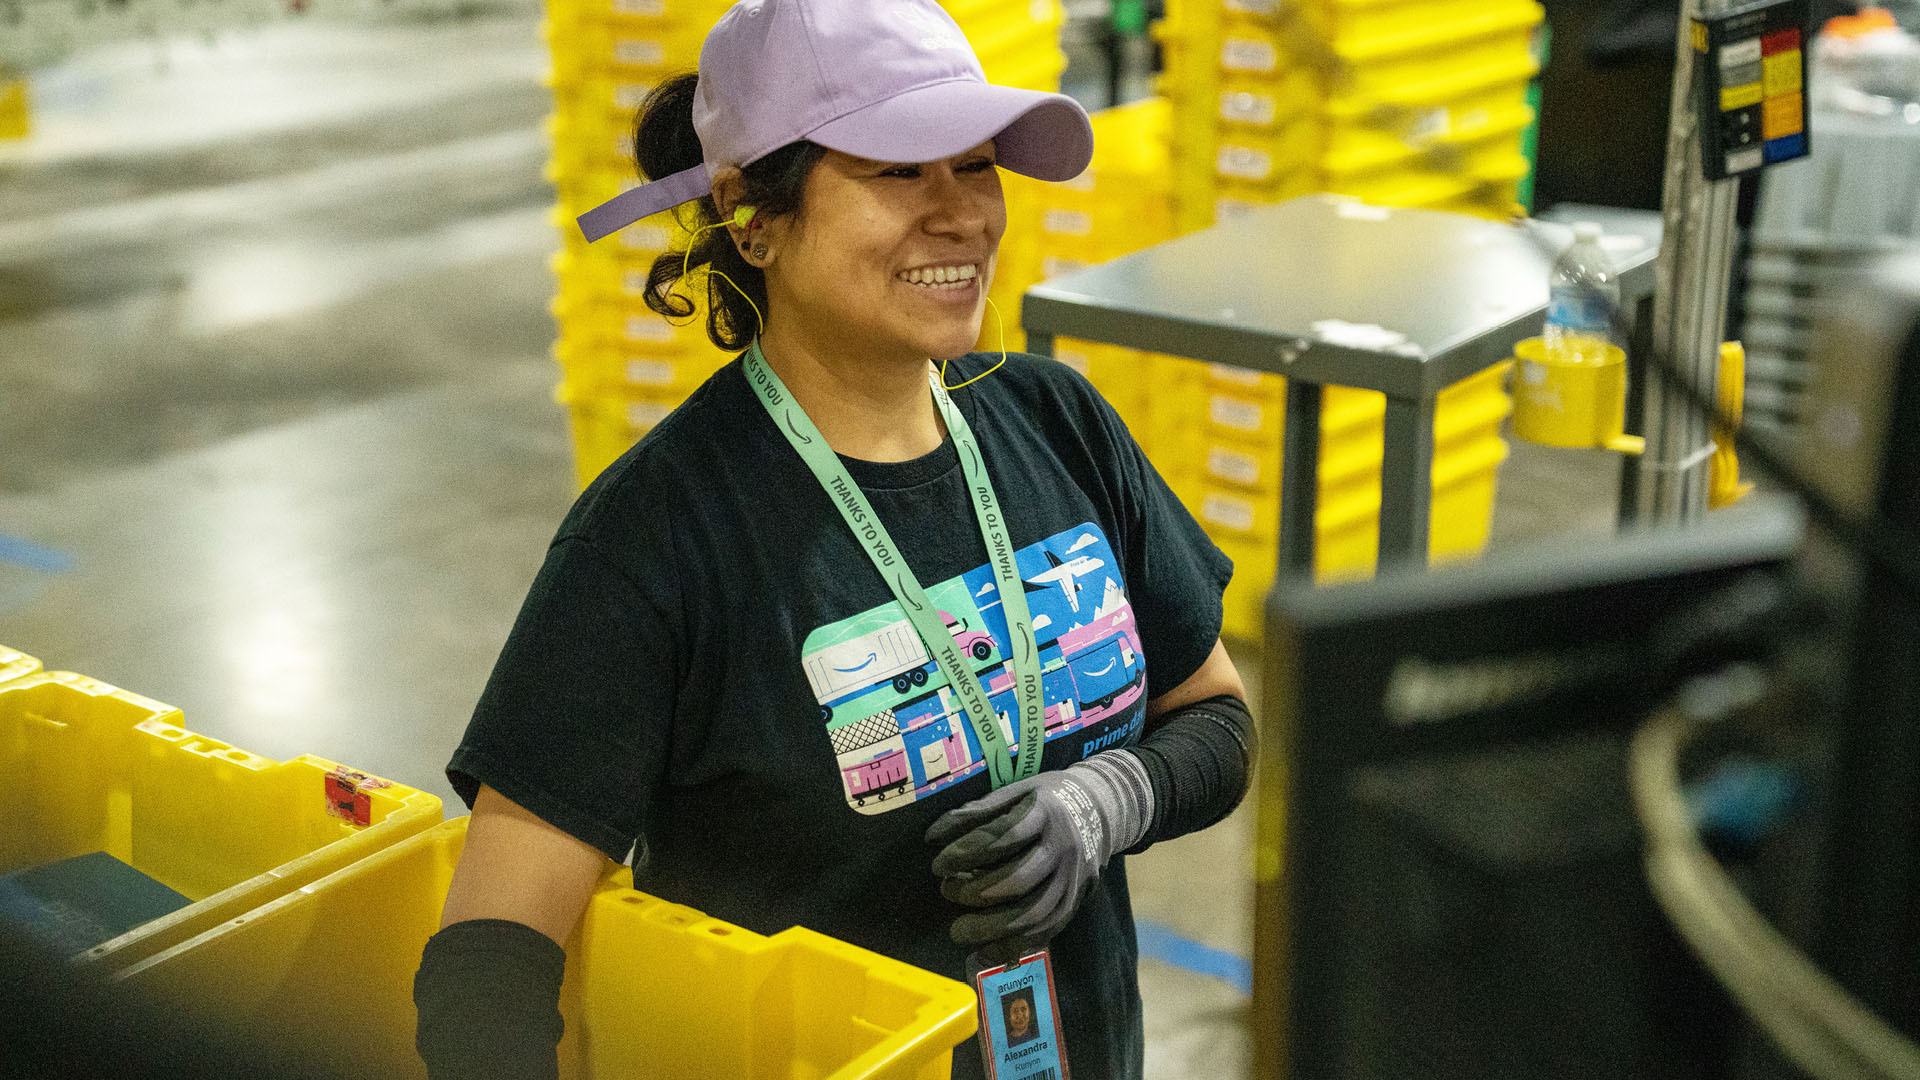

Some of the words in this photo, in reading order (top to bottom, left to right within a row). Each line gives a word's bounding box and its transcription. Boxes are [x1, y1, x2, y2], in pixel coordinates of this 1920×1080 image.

[754, 367, 767, 385] TO
[763, 381, 784, 406] YOU
[977, 486, 993, 511] YOU
[830, 475, 867, 523] THANKS
[861, 521, 877, 541] TO
[872, 540, 895, 567] YOU
[986, 513, 999, 530] TO
[991, 531, 1014, 582] THANKS
[941, 646, 975, 696] THANKS
[969, 695, 984, 714] TO
[978, 714, 997, 742] YOU
[1024, 674, 1037, 702] YOU
[1027, 705, 1038, 724] TO
[1023, 725, 1039, 777] THANKS
[1082, 723, 1129, 760] prime
[998, 974, 1034, 994] arunyon
[1004, 1041, 1048, 1063] Alexandra
